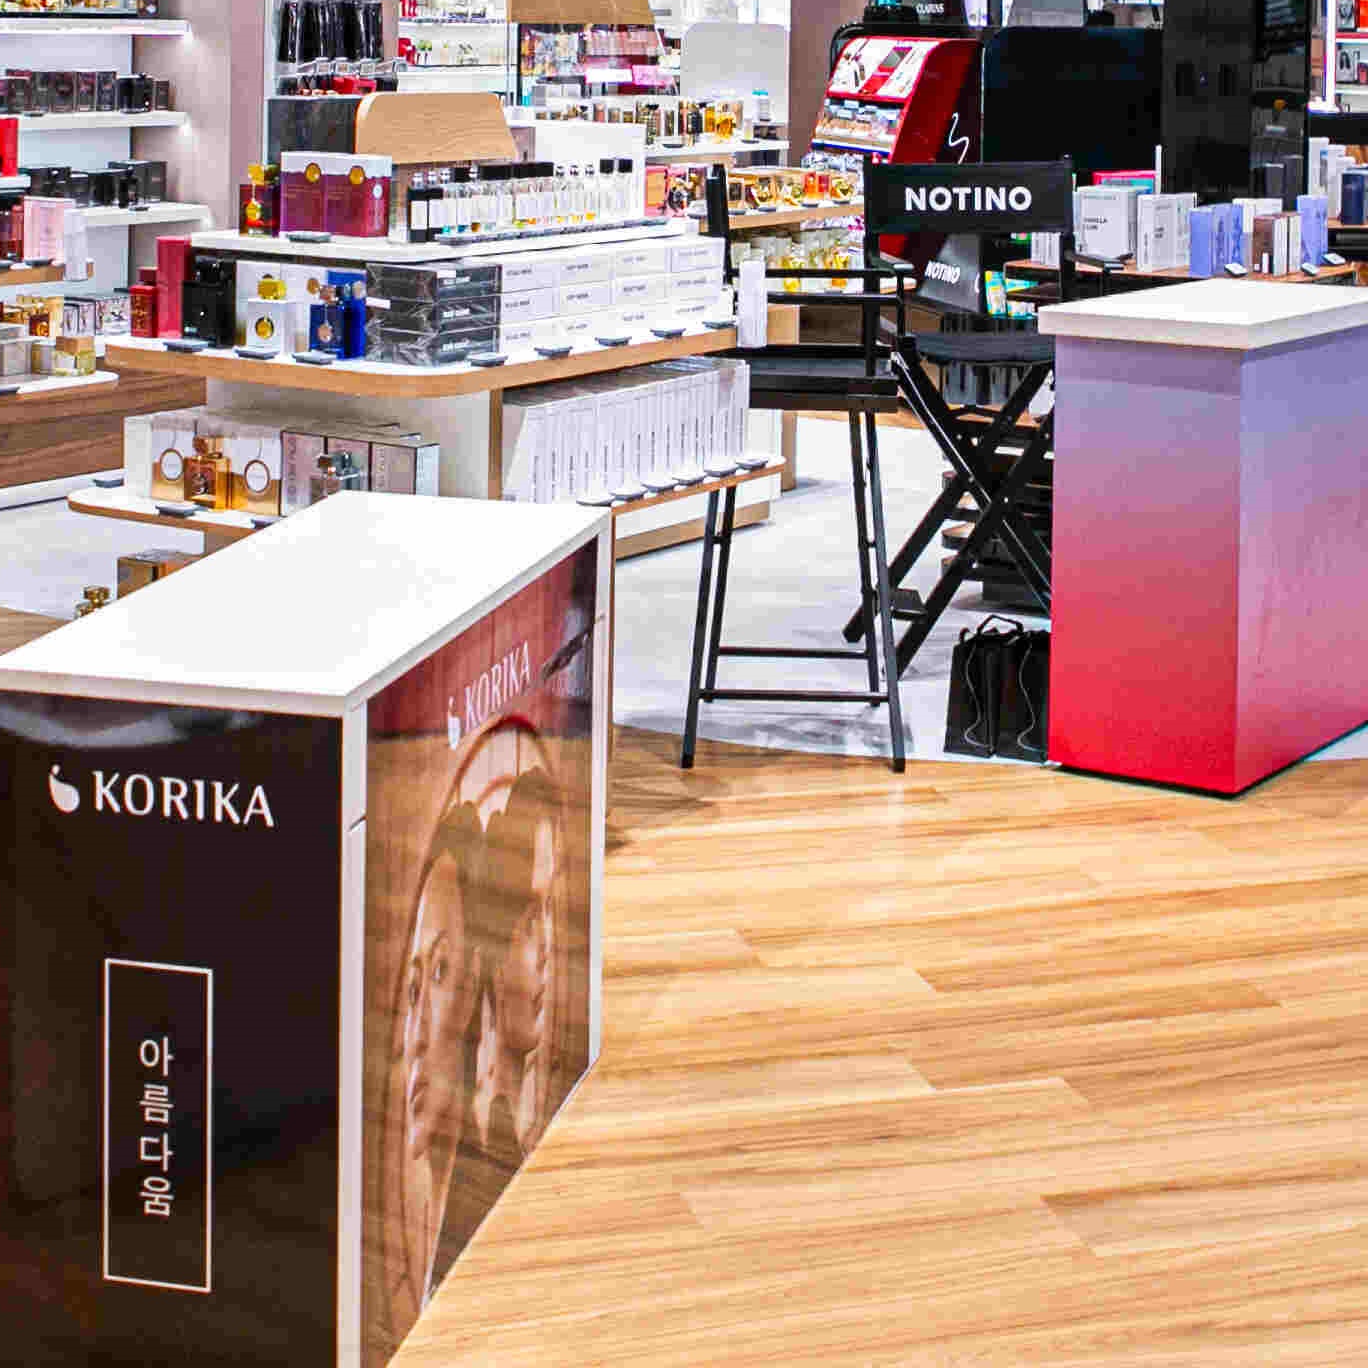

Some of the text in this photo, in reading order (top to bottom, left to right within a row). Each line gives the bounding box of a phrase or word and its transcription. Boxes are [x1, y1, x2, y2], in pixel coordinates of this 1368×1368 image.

[904, 185, 1033, 212] NOTINO
[924, 261, 961, 284] NOTINO
[465, 639, 531, 734] KORIKA
[92, 769, 275, 829] KORIKA
[139, 1035, 175, 1217] 아름다움
